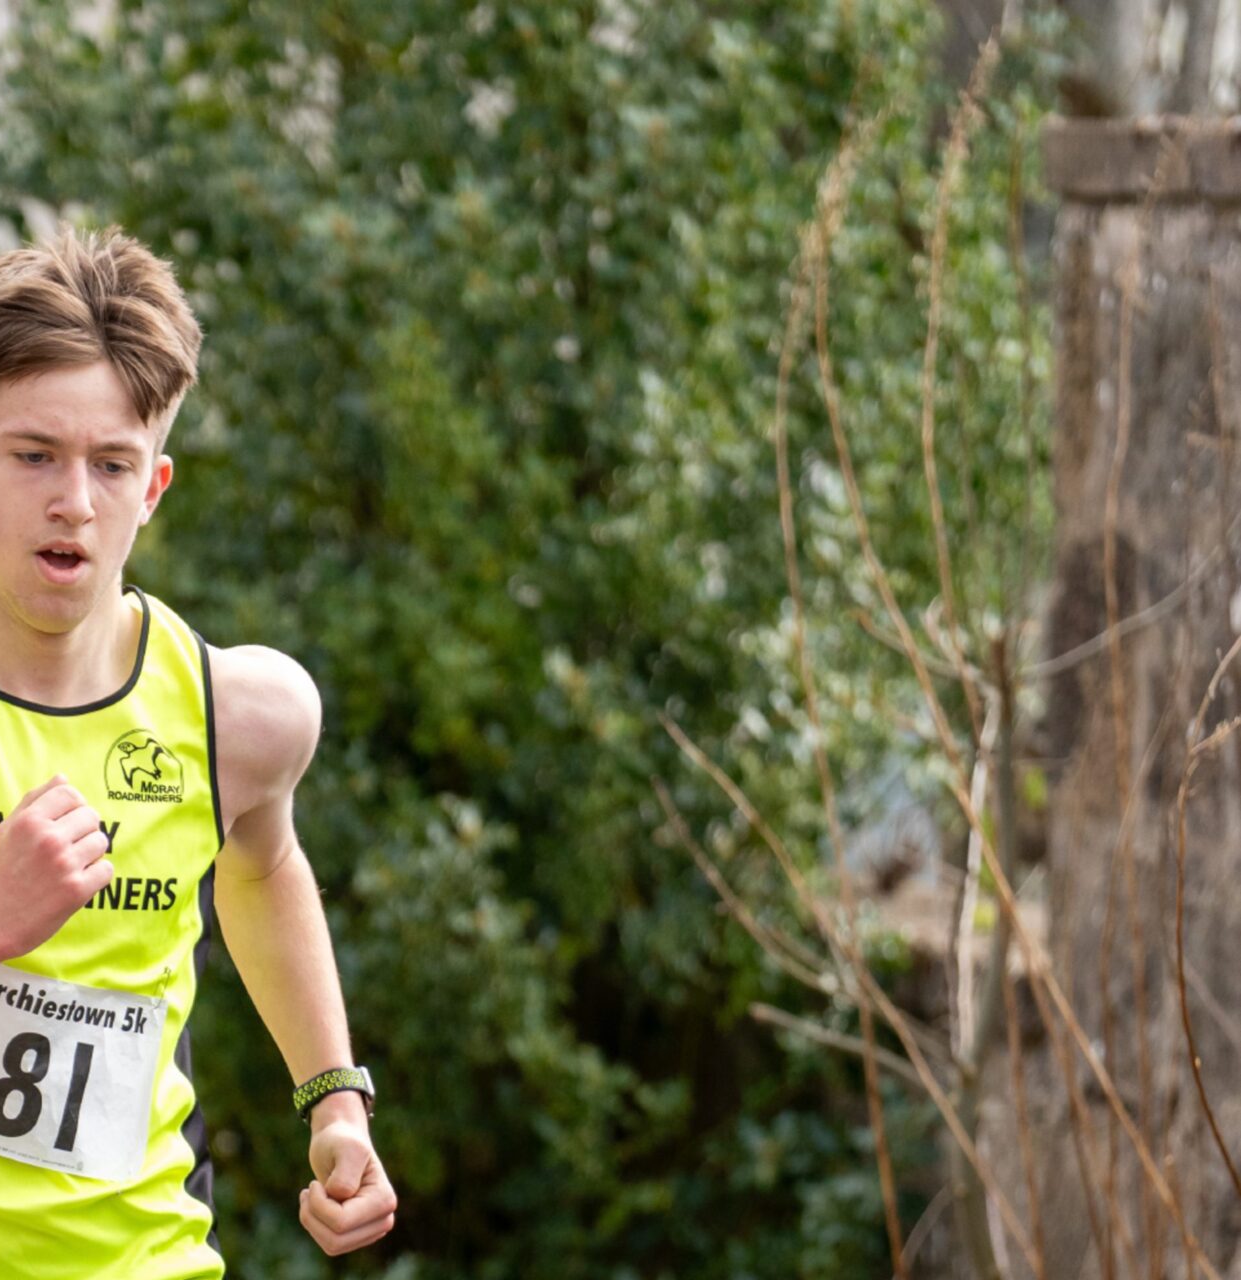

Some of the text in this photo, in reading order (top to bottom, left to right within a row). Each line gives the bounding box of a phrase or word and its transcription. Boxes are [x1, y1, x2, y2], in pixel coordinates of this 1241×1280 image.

[141, 781, 180, 793] MORAY
[108, 790, 183, 803] ROADRUNNERS
[121, 1007, 147, 1034] 5k
